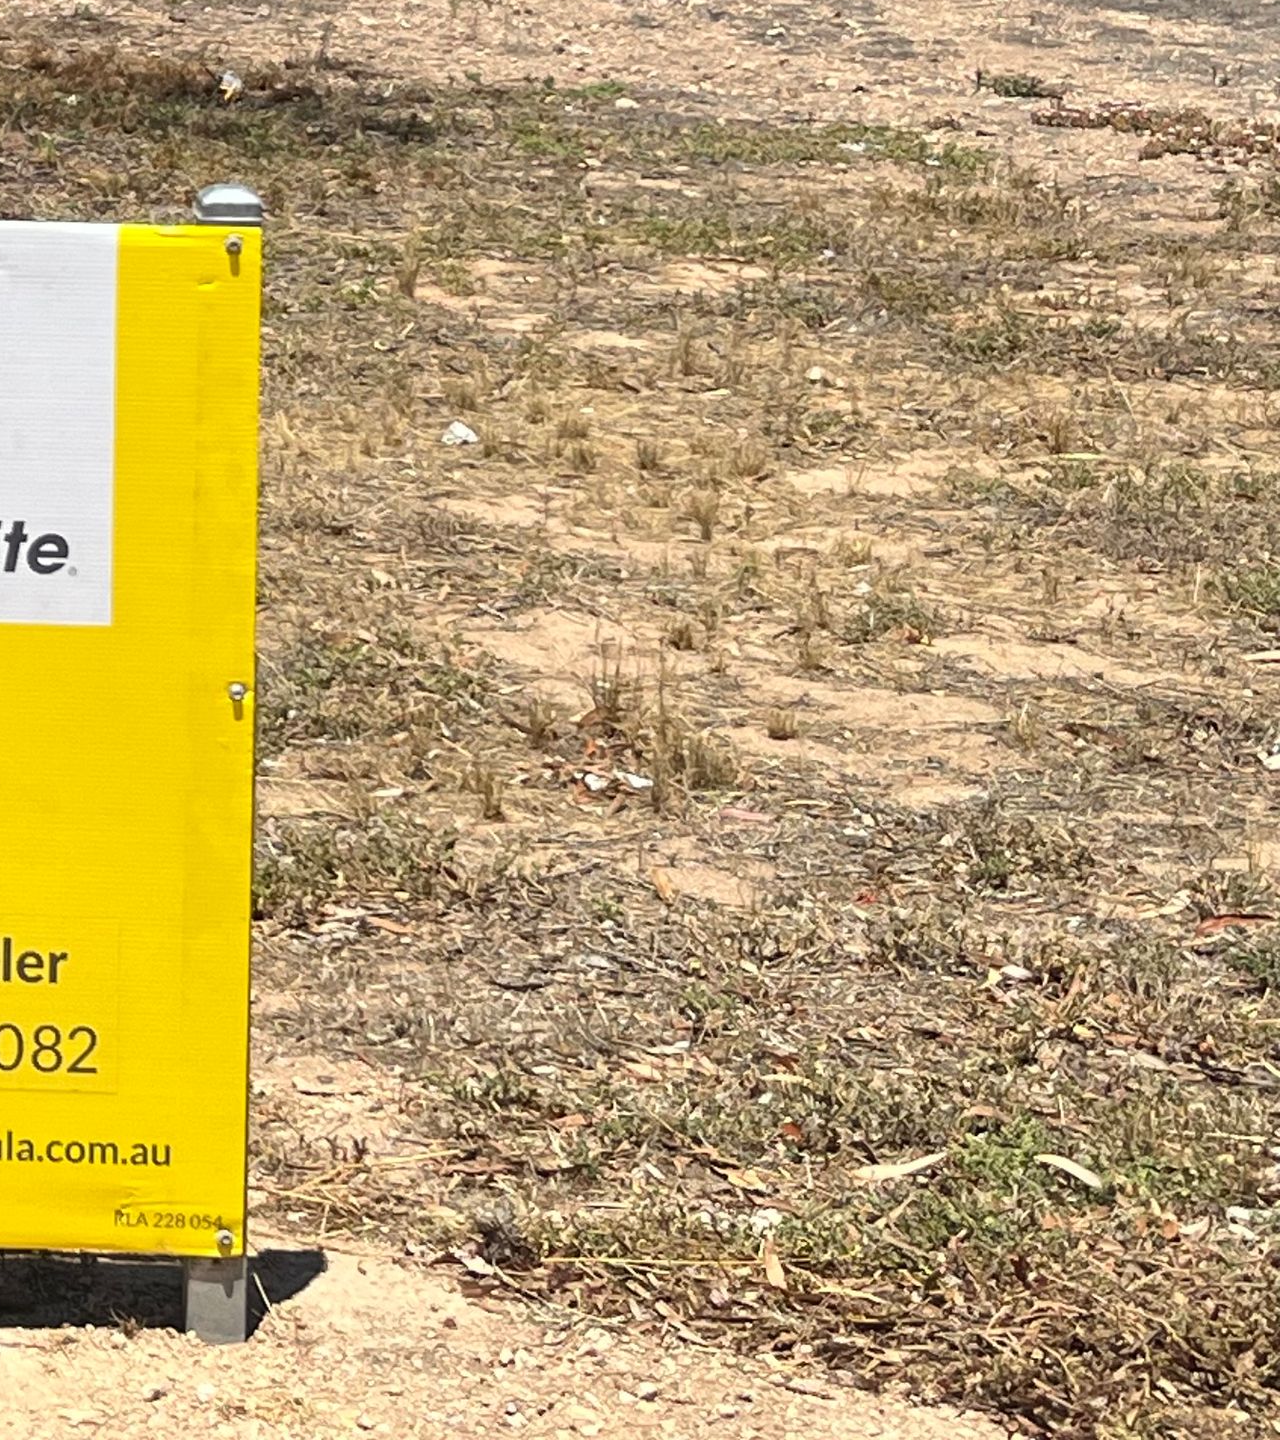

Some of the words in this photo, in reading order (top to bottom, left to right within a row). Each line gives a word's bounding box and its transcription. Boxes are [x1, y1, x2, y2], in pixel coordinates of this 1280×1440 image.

[114, 1210, 148, 1227] RLA
[153, 1212, 186, 1229] 228
[190, 1214, 224, 1230] 054
